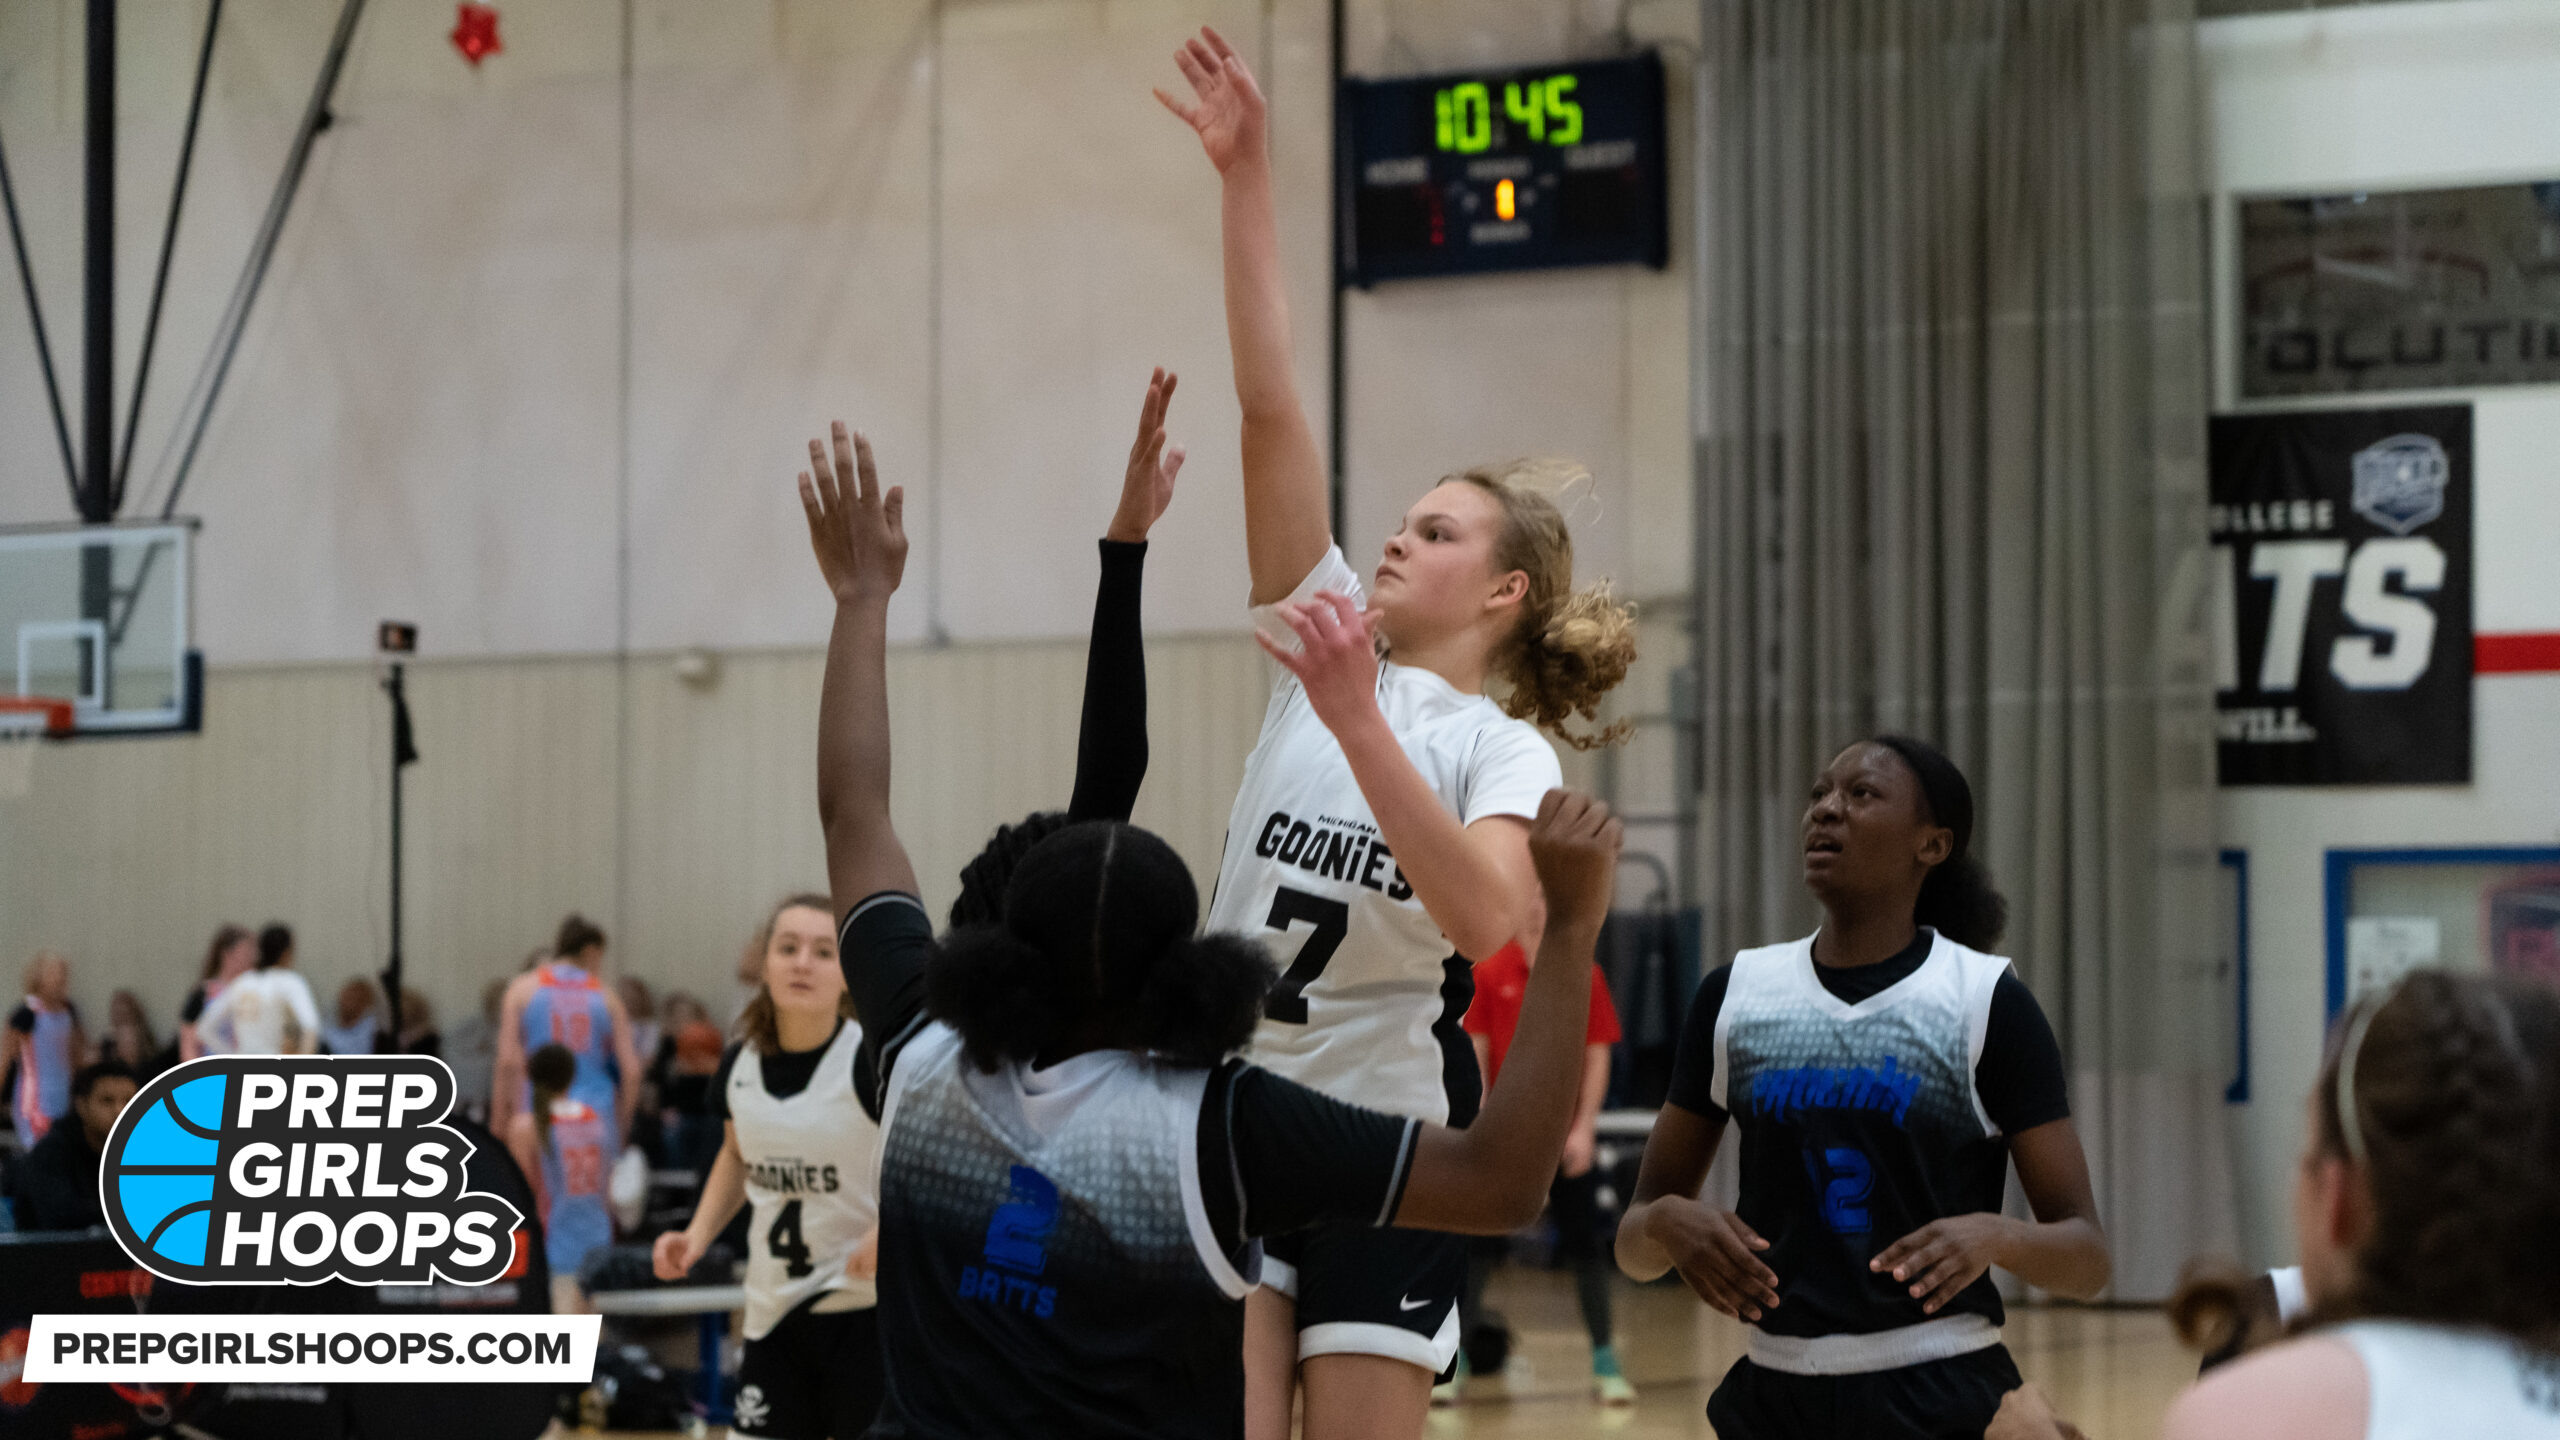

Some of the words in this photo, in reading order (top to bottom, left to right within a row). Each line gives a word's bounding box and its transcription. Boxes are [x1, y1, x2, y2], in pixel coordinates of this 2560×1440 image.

[2211, 499, 2334, 532] OLLEGE
[1264, 886, 1349, 1024] 7
[768, 1199, 815, 1279] 4
[984, 1165, 1061, 1276] 2
[958, 1266, 1057, 1319] BATTS
